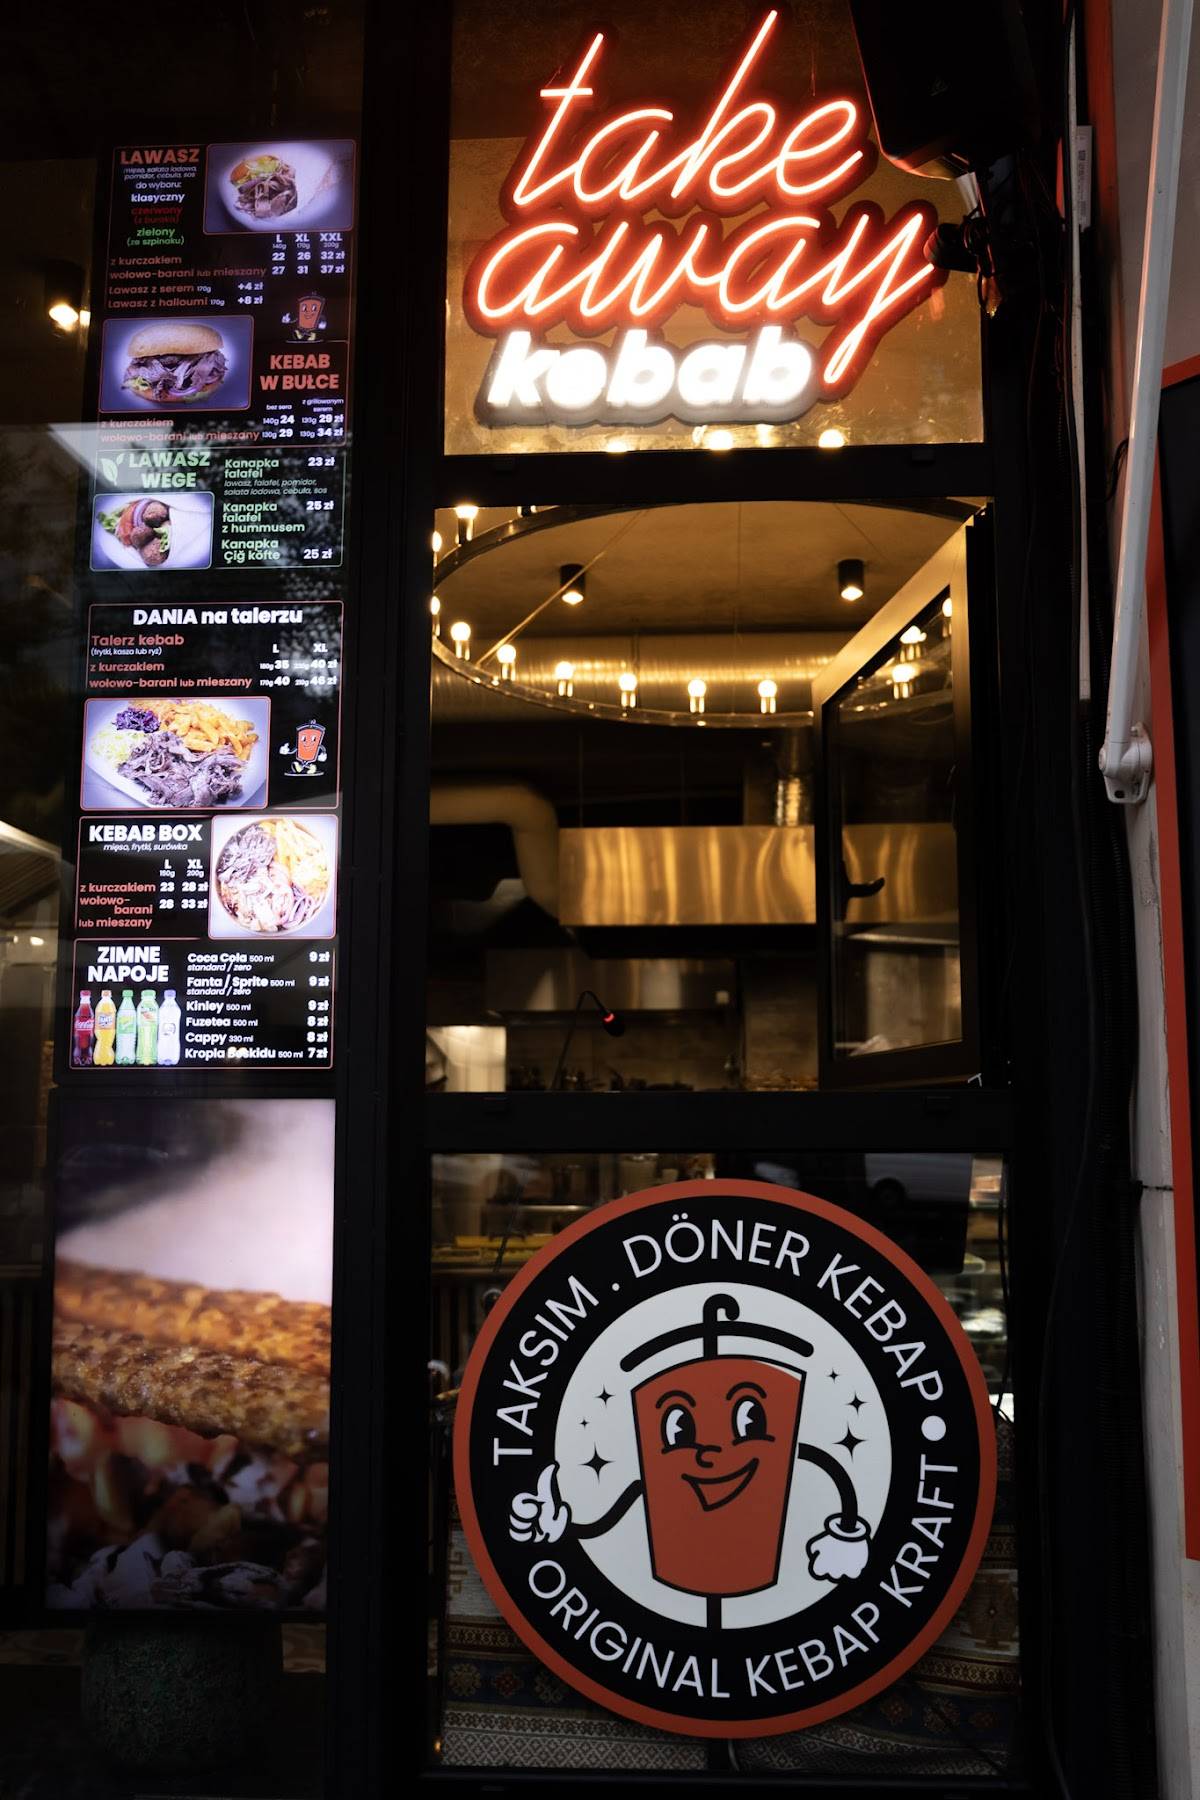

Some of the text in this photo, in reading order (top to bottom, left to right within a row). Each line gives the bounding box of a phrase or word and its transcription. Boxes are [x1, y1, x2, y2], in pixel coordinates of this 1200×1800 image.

[513, 9, 863, 205] take
[121, 149, 200, 164] LAWASZ
[136, 181, 147, 189] do
[131, 193, 185, 203] klasyczny
[137, 227, 176, 237] zielony
[276, 232, 343, 243] L XL XXL
[142, 235, 185, 246] szpinaku)
[119, 256, 182, 265] kurczakiem
[272, 252, 286, 261] 22
[297, 251, 311, 260] 26
[320, 251, 334, 260] 32
[335, 251, 345, 260] zł
[272, 266, 286, 275] 27
[297, 265, 309, 274] 31
[320, 265, 334, 274] 37
[335, 265, 345, 274] zł
[109, 286, 149, 294] Lawasz
[160, 285, 195, 293] serem
[238, 282, 252, 290] +4
[254, 282, 264, 290] zł
[108, 299, 148, 309] Lawasz
[159, 297, 208, 307] halloumi
[237, 296, 252, 304] +8
[253, 296, 263, 304] zł
[477, 212, 935, 384] away
[270, 354, 331, 369] KEBAB
[487, 325, 812, 406] kebab
[260, 374, 339, 390] W BUŁCE
[110, 418, 174, 428] kurczakiem
[280, 414, 295, 424] 24
[334, 414, 344, 423] zł
[205, 428, 343, 441] mieszany 29 34 zł
[128, 451, 210, 468] LAWASZ
[225, 457, 335, 470] Kanapka 23 zł
[141, 472, 196, 488] WEGE
[225, 469, 263, 478] falafel
[223, 501, 334, 514] Kanapka 25 zł
[223, 513, 261, 522] falafel
[222, 523, 305, 533] z hummusem
[221, 539, 279, 550] Kanapka
[303, 549, 319, 559] 25
[321, 549, 333, 559] zł
[133, 607, 303, 625] DANIA na talerzu
[92, 634, 184, 646] Talerz kebab
[272, 642, 328, 653] L XL
[90, 664, 96, 672] z
[98, 662, 165, 672] kurczakiem
[274, 660, 289, 669] 35
[310, 659, 326, 669] 40
[327, 659, 338, 669] zł
[180, 678, 194, 687] lub
[196, 676, 252, 688] mieszany
[274, 676, 290, 686] 40
[327, 676, 337, 685] zł
[89, 824, 203, 842] KEBAB BOX
[164, 859, 203, 869] L XL
[80, 884, 86, 892] z
[88, 882, 156, 892] kurczakiem
[160, 881, 175, 892] 23
[197, 881, 208, 892] zł
[114, 904, 153, 914] barani
[181, 898, 196, 909] 33
[197, 898, 208, 909] zł
[79, 917, 152, 929] lub mieszany
[97, 946, 160, 963] ZIMNE
[187, 953, 218, 963] Coca
[220, 952, 247, 963] Cola
[309, 951, 318, 962] 9
[319, 951, 330, 962] zł
[87, 965, 169, 982] NAPOJE
[187, 963, 226, 971] standard
[186, 977, 223, 987] Fanta
[232, 976, 268, 989] Sprite
[318, 976, 330, 986] zł
[186, 987, 225, 995] standard
[186, 1001, 224, 1014] Kinley
[241, 1003, 251, 1011] ml
[317, 1000, 329, 1011] zł
[186, 1016, 231, 1027] Fuzetea
[248, 1019, 258, 1027] ml
[317, 1016, 329, 1027] zł
[185, 1032, 227, 1045] Cappy
[317, 1031, 328, 1042] zł
[185, 1048, 225, 1061] Kropla
[308, 1047, 316, 1058] 7
[316, 1047, 328, 1058] zł
[493, 1213, 944, 1466] TAKSIM DÖNER KEBAP
[527, 1454, 958, 1698] ORIGINAL KEBAP KRAFT
